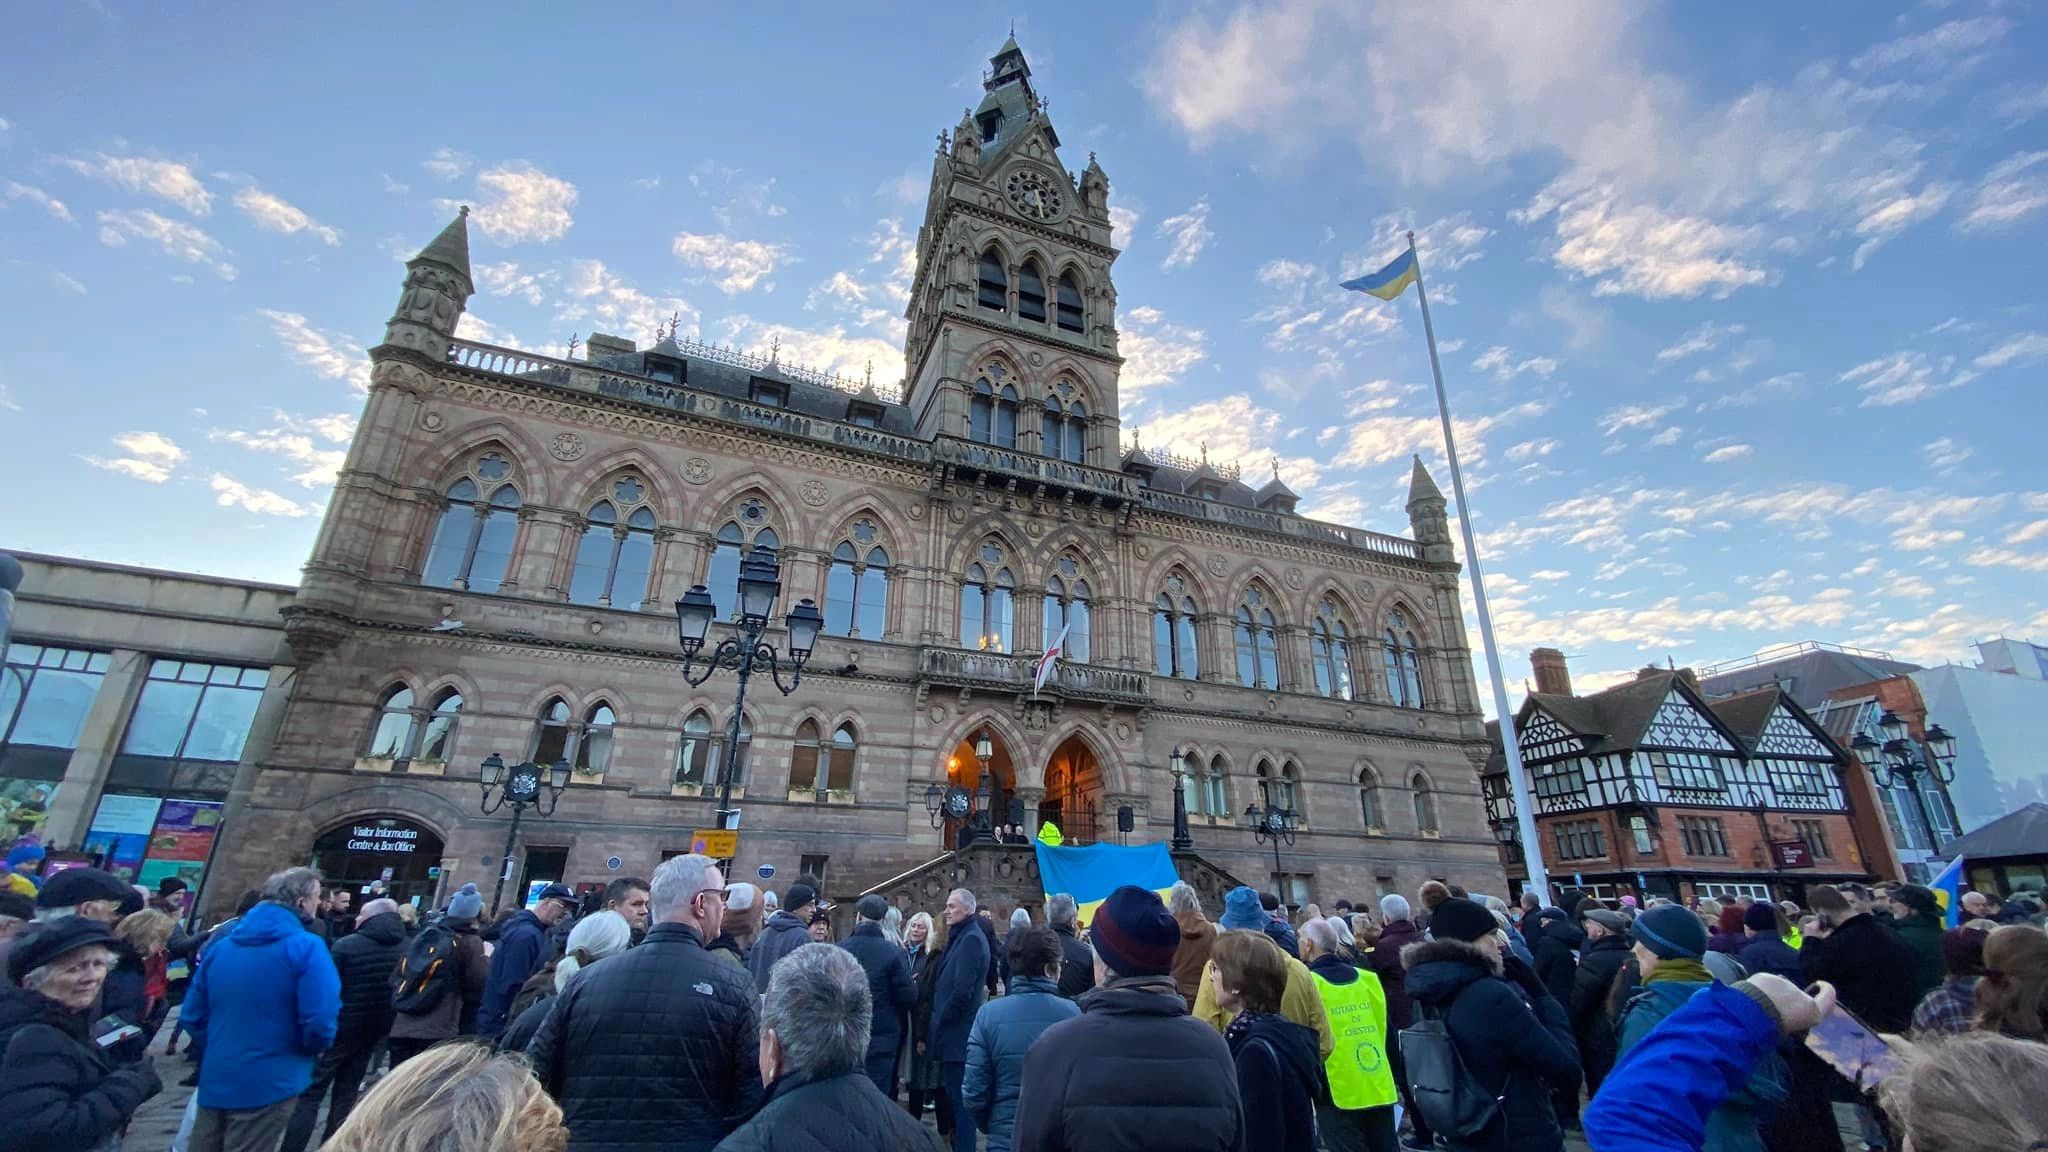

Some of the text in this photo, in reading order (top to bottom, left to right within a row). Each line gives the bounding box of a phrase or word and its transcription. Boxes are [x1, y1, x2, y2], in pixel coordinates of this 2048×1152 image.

[354, 825, 418, 839] Visitor Information
[347, 839, 416, 852] Centre & Box Office
[1330, 1001, 1370, 1016] ROTARY CLU
[1351, 1015, 1361, 1024] OF
[1344, 1025, 1377, 1037] CHESTER
